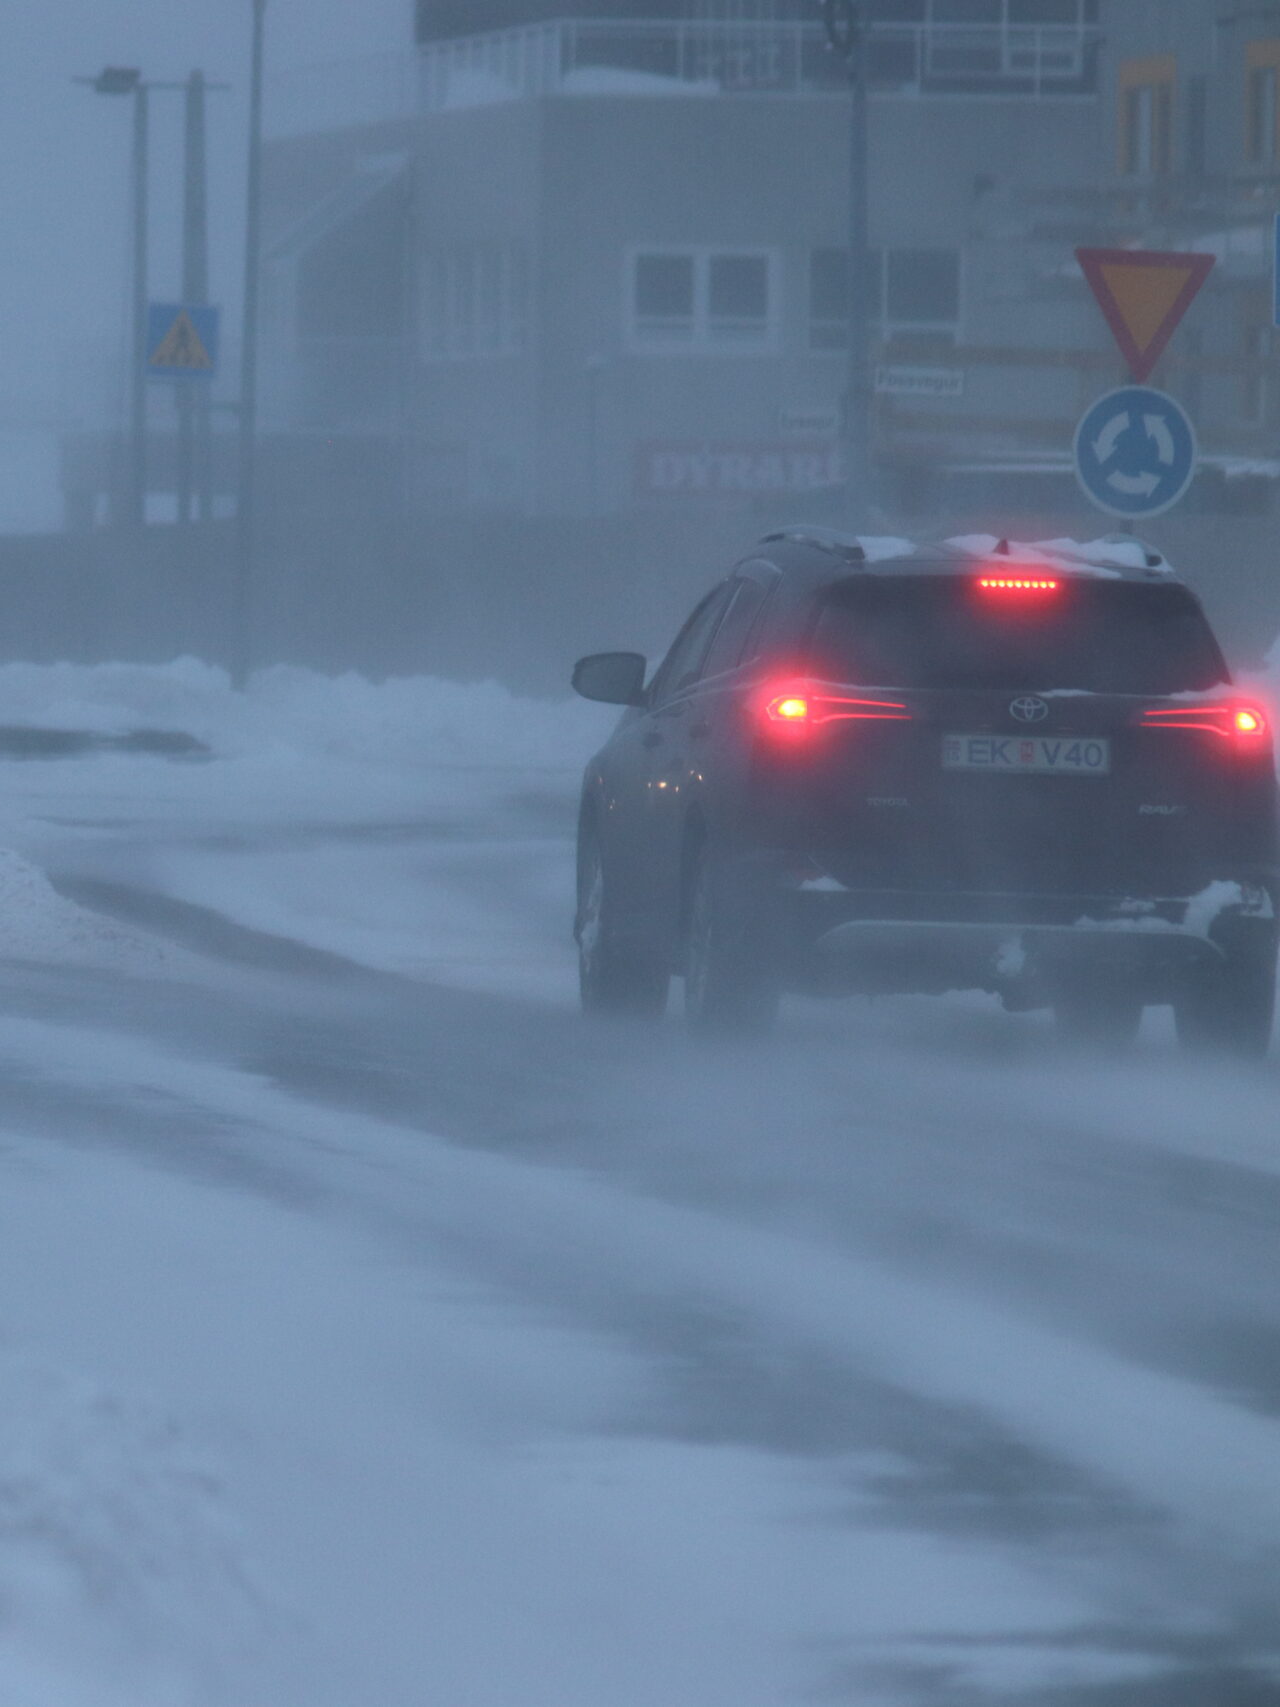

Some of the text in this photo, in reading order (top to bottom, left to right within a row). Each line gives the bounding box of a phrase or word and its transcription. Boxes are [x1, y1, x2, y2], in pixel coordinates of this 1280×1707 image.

[967, 739, 1012, 764] EK
[1040, 740, 1104, 767] V40
[866, 797, 911, 808] TOYOTA
